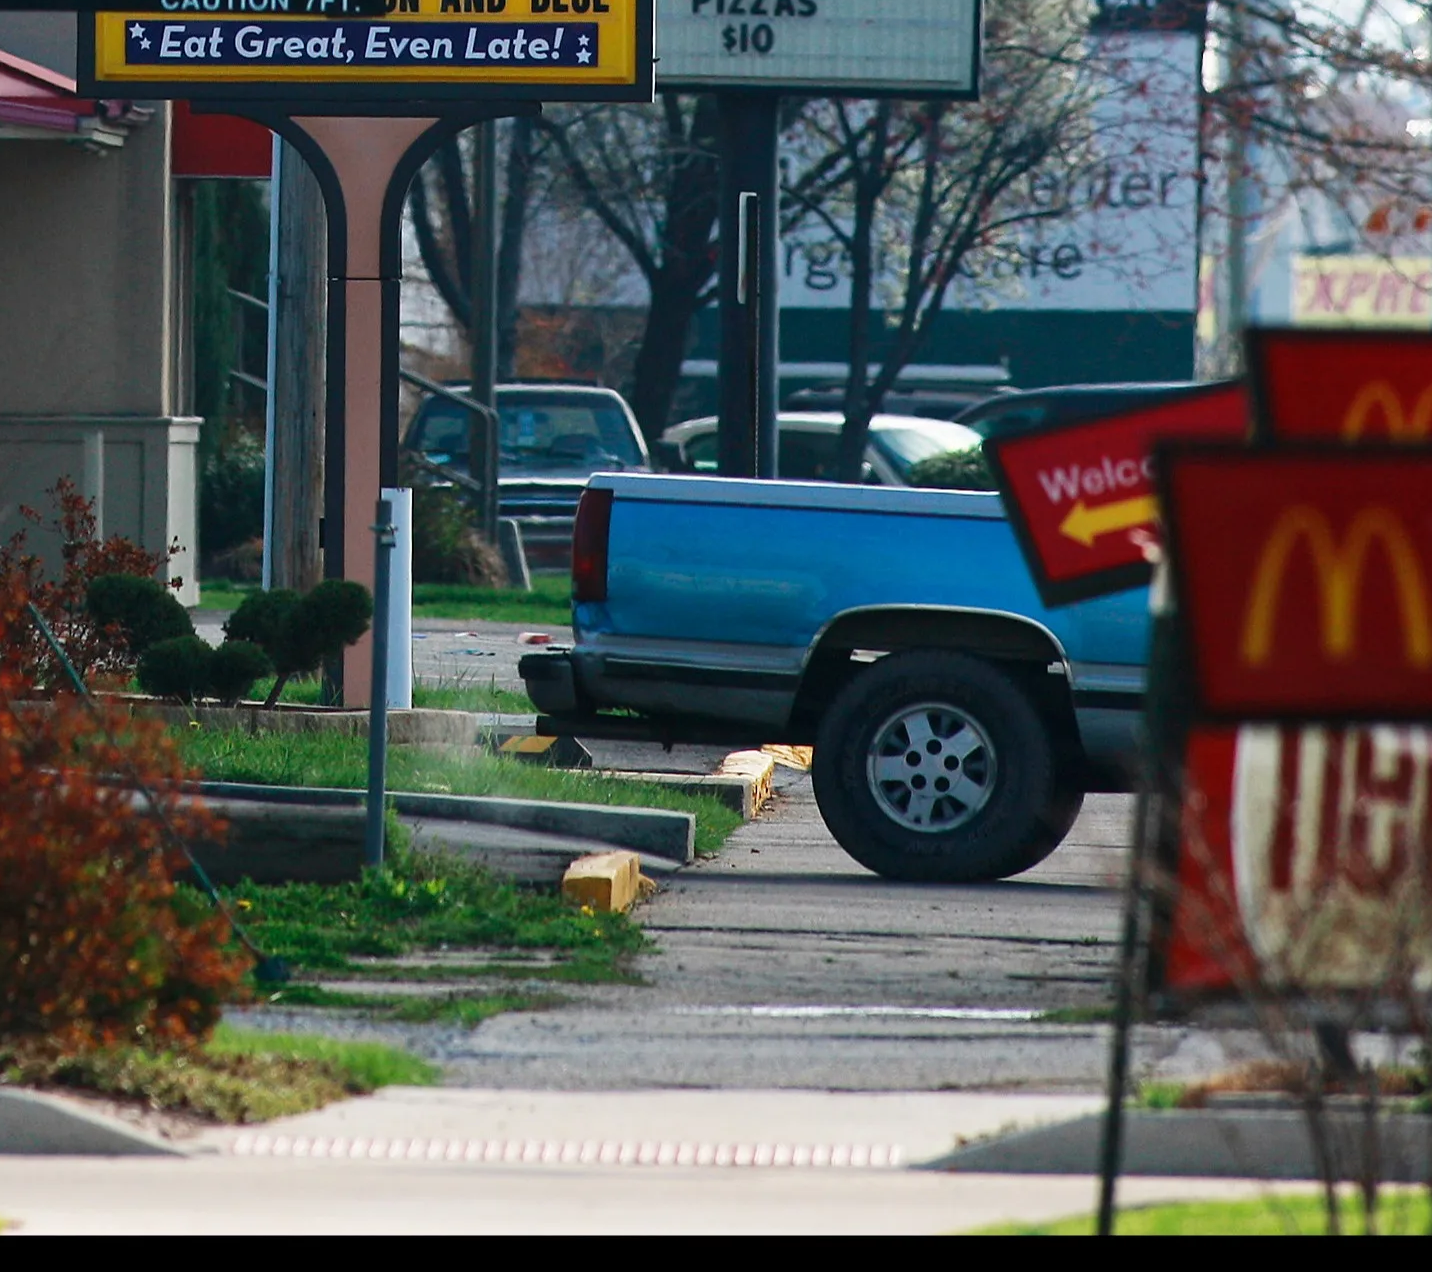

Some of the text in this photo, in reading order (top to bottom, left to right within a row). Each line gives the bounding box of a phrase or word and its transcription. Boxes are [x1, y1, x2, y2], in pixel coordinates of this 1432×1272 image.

[160, 25, 564, 64] Eat Great, Even Late!
[722, 23, 775, 55] $10
